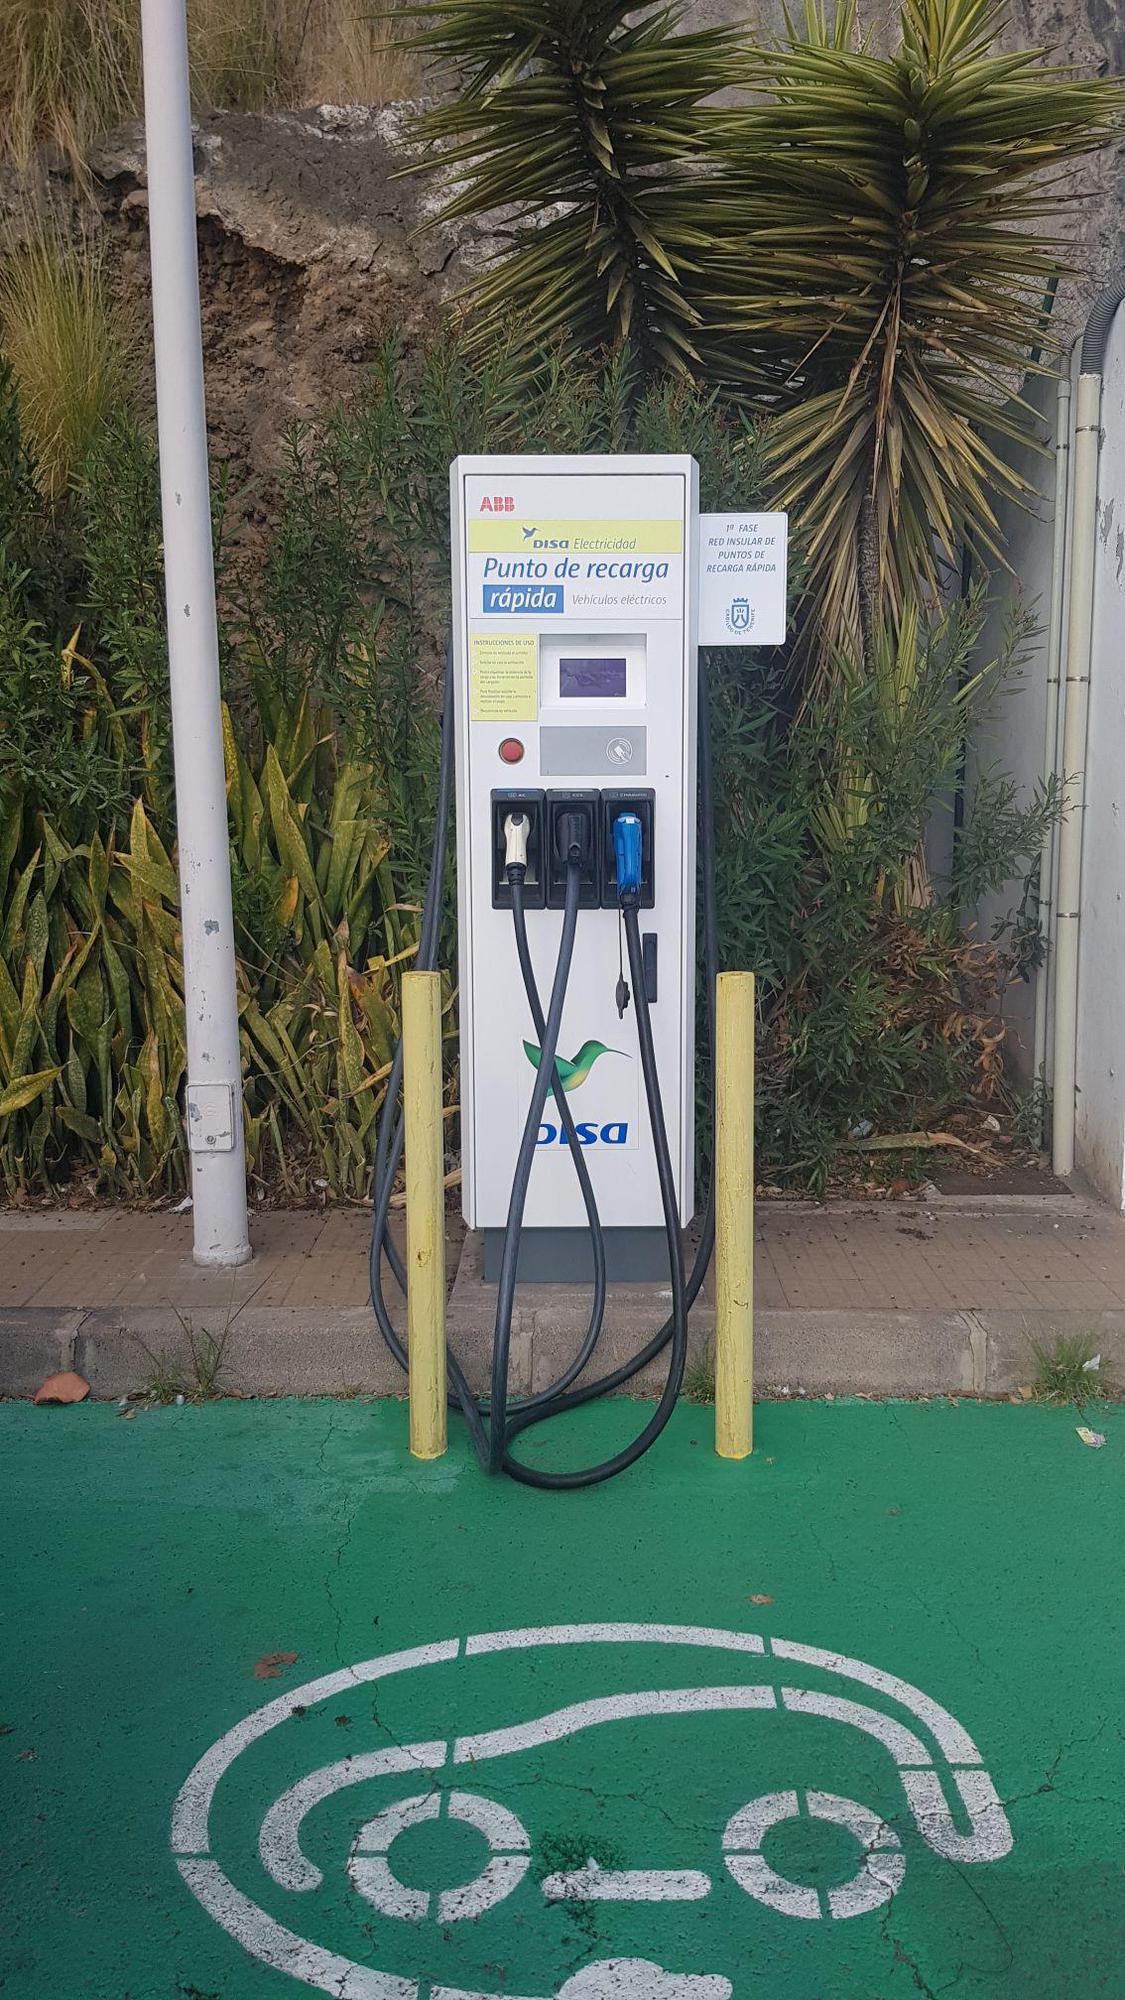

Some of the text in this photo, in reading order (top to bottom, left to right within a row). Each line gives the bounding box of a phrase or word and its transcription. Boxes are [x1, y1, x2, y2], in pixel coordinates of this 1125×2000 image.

[479, 496, 515, 512] ABB
[738, 524, 759, 532] FASE
[573, 538, 636, 550] Electricidad
[708, 537, 776, 546] RED INSULAR DE
[718, 550, 766, 559] PUNTOS DE
[483, 557, 670, 583] Punto de recarga
[706, 562, 776, 573] RECARGA RÁPIDA
[489, 587, 667, 612] rápida Vehículos eléctricos
